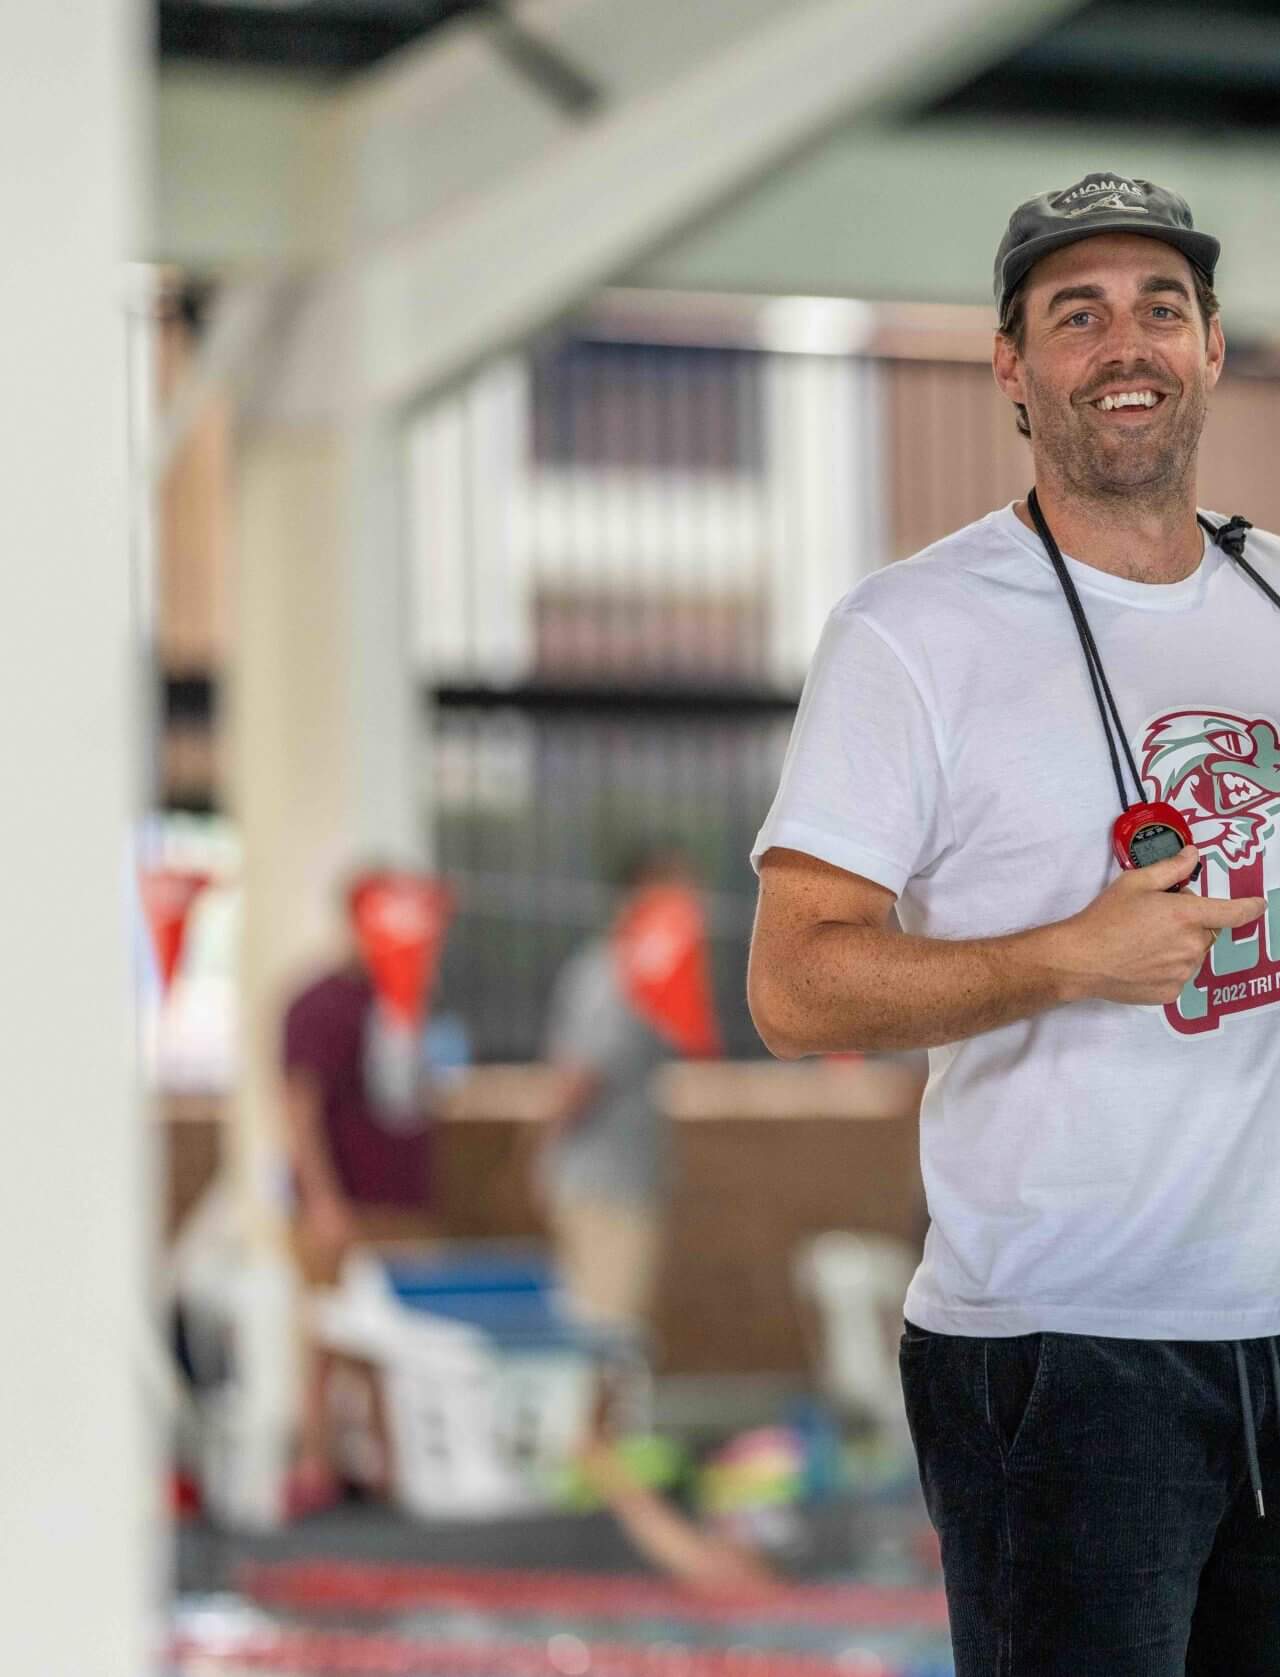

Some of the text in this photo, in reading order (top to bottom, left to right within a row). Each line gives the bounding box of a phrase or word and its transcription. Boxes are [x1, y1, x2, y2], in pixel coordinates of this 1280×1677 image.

[1063, 181, 1143, 204] THOMAS
[1213, 982, 1247, 1006] 2022
[1248, 976, 1272, 997] TRI
